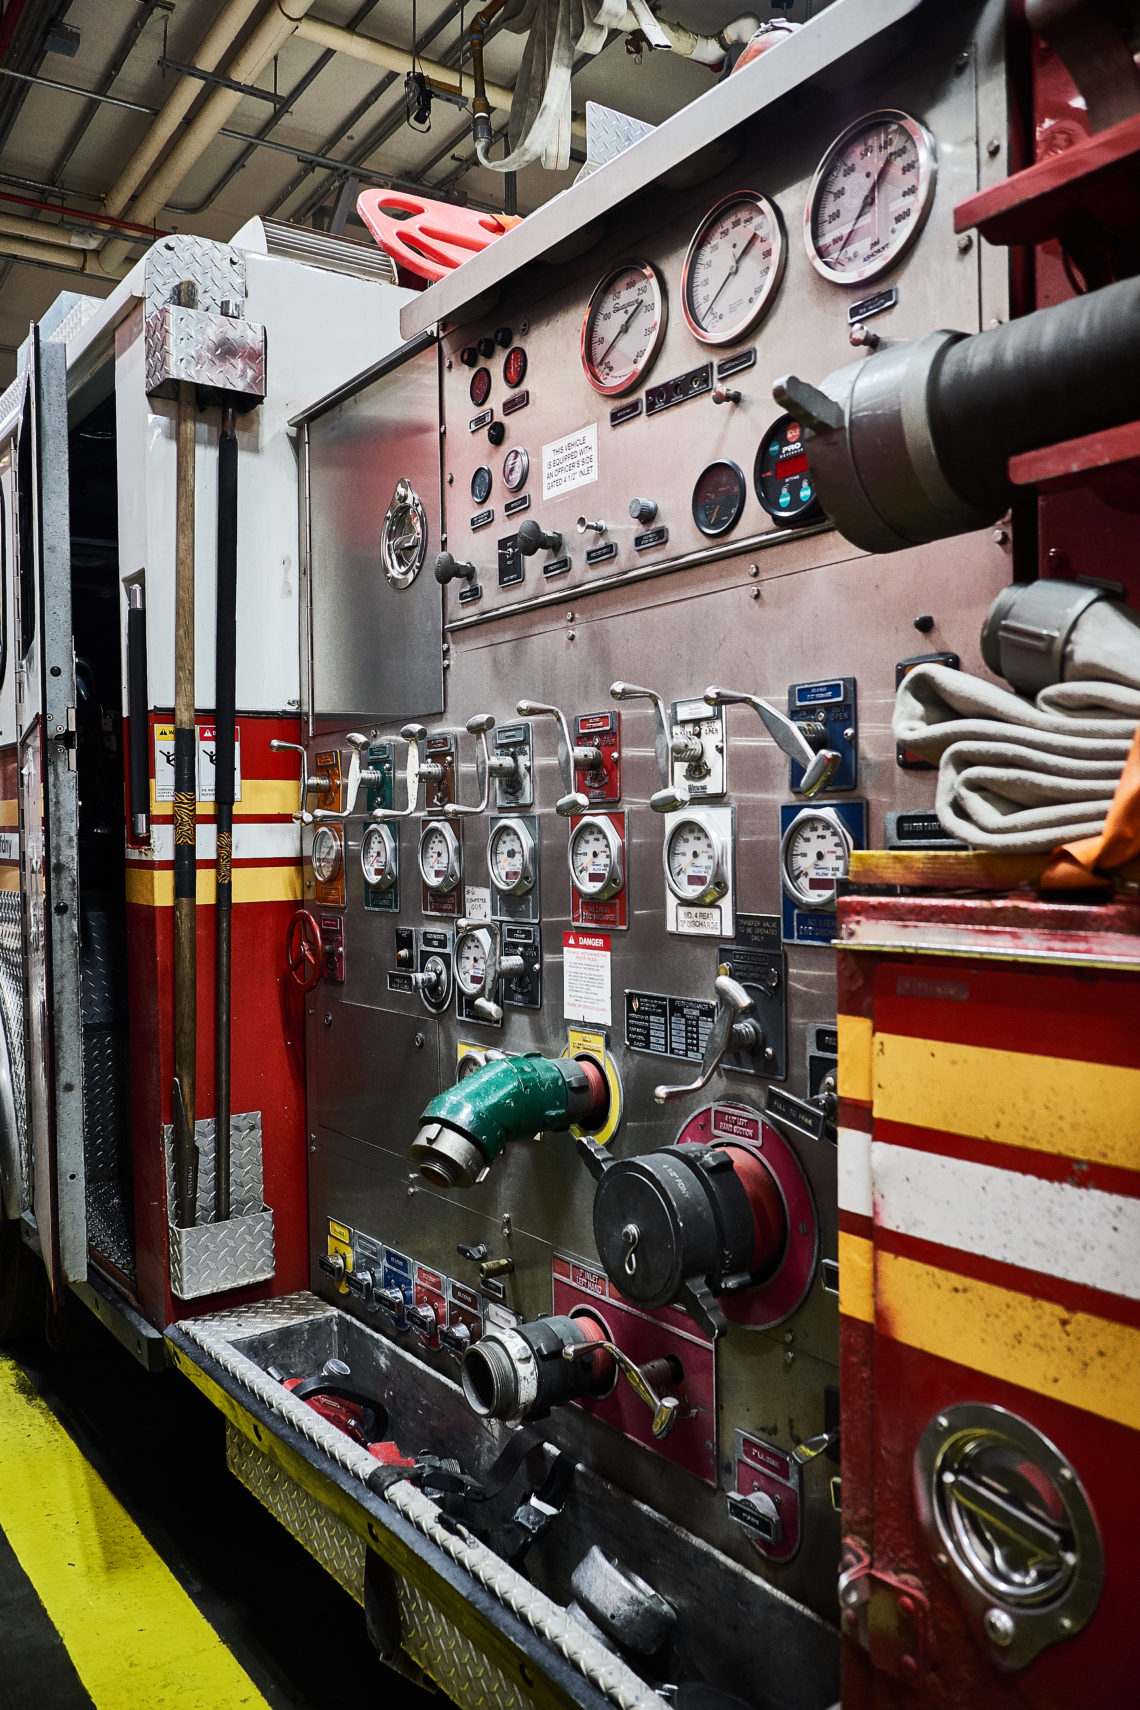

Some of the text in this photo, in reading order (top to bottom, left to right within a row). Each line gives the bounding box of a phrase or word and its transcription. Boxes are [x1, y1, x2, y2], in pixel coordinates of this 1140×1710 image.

[843, 164, 856, 177] 400
[834, 187, 845, 201] 300
[828, 210, 840, 223] 200
[895, 208, 910, 224] 1000
[720, 228, 729, 239] 250
[832, 237, 843, 246] 100
[626, 280, 636, 290] 200
[613, 291, 621, 300] 150
[637, 286, 647, 296] 250
[645, 303, 654, 313] 300
[603, 312, 611, 321] 100
[598, 337, 604, 345] 50
[553, 436, 586, 456] THIS VEHICLE
[782, 443, 801, 453] PRO
[553, 451, 578, 467] EQUIPPED
[580, 445, 592, 456] WITH
[555, 460, 580, 476] OFFICER'S
[582, 455, 593, 466] SIDE
[547, 478, 562, 490] GATED
[568, 472, 577, 480] 1/2"
[579, 465, 593, 477] INLET
[687, 920, 718, 929] DISCHARGE
[579, 937, 604, 947] DANGER
[675, 1001, 708, 1010] PERFORMANCE
[774, 1101, 786, 1112] PULL
[790, 1109, 796, 1117] TO
[737, 1118, 748, 1126] LEFT
[720, 1122, 753, 1137] HAND SUCTION
[676, 1179, 691, 1198] FDNY
[585, 1272, 598, 1284] INLET
[577, 1276, 601, 1295] LEFT HAND
